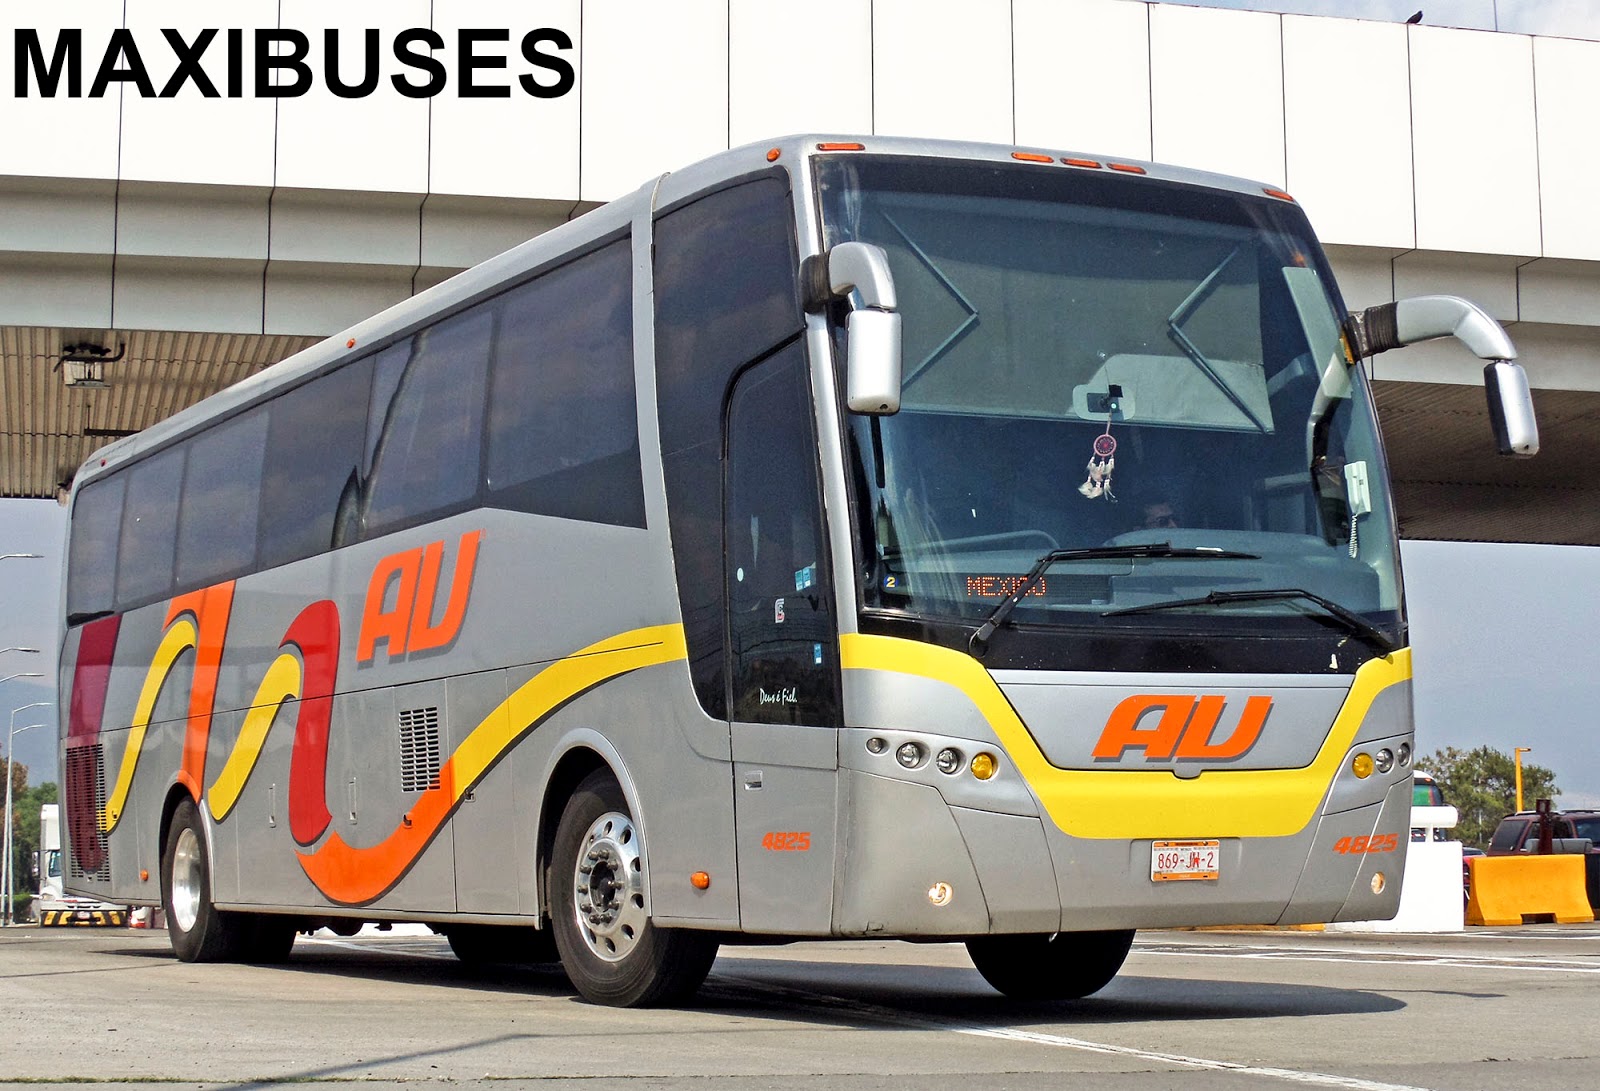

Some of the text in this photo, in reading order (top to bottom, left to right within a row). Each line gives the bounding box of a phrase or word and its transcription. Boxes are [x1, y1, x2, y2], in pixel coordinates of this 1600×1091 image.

[886, 576, 896, 588] 2
[356, 529, 481, 670] AU
[759, 687, 776, 705] Deus
[1091, 694, 1274, 763] AU
[761, 831, 811, 851] 4825
[1332, 833, 1399, 855] 4825
